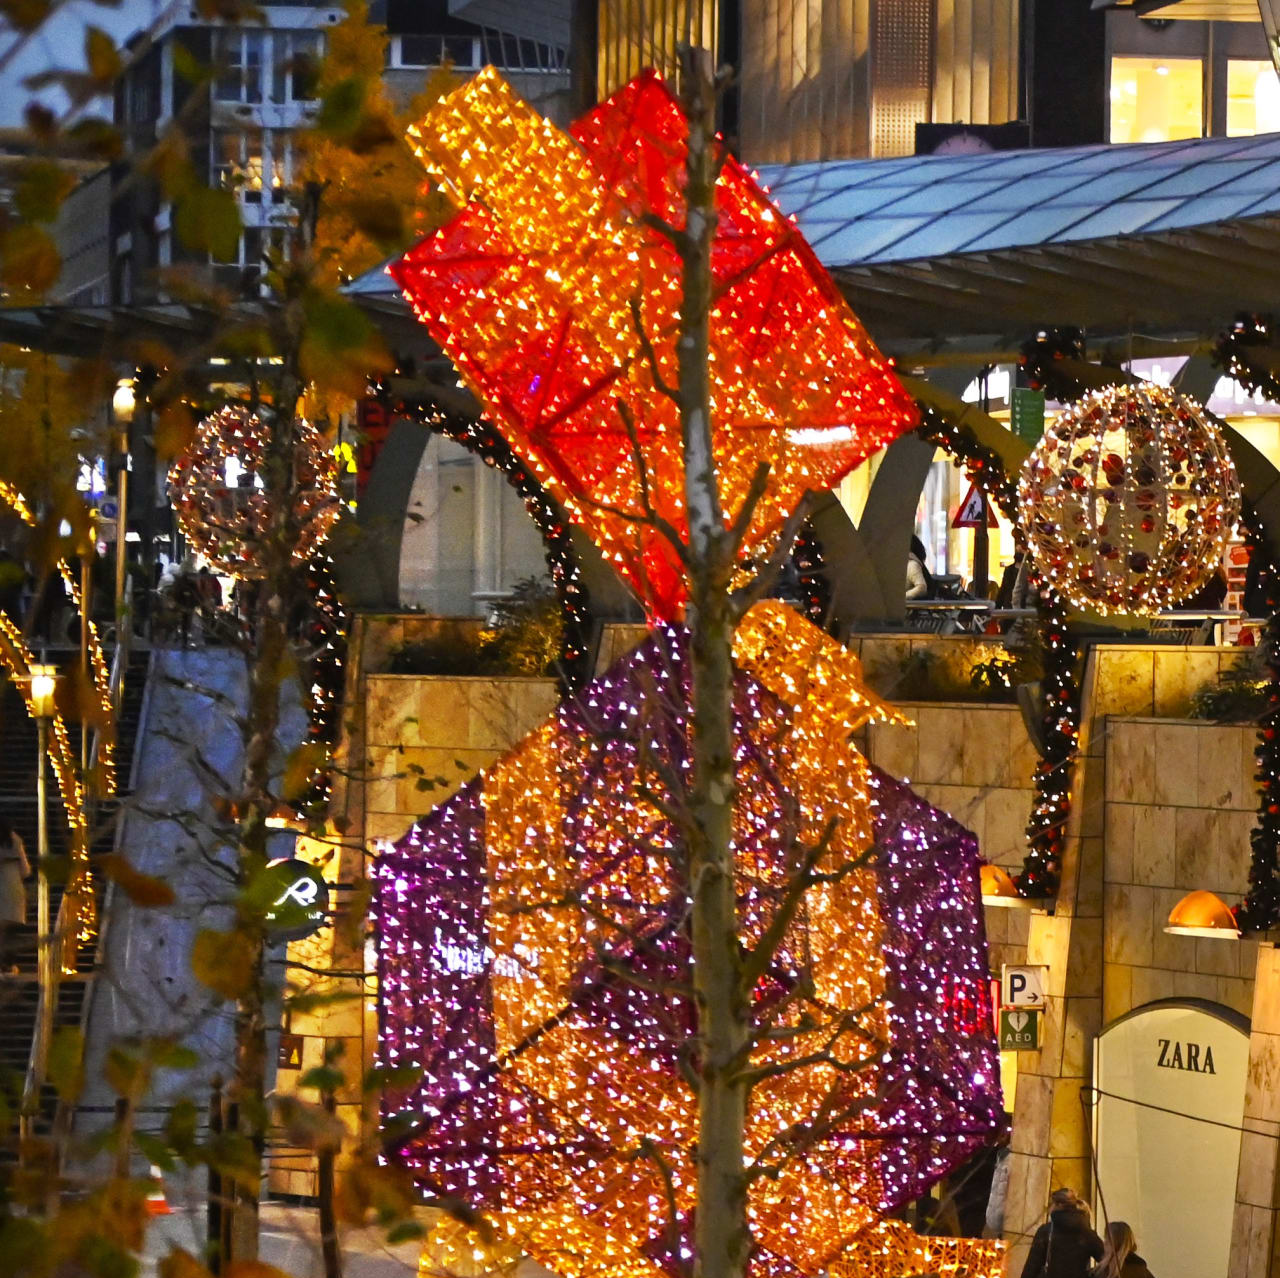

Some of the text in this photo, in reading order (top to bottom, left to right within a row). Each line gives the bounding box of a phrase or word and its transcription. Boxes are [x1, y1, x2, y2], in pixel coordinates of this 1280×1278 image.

[1010, 973, 1027, 1003] P
[1006, 1033, 1032, 1042] AED
[1157, 1038, 1217, 1075] ZARA
